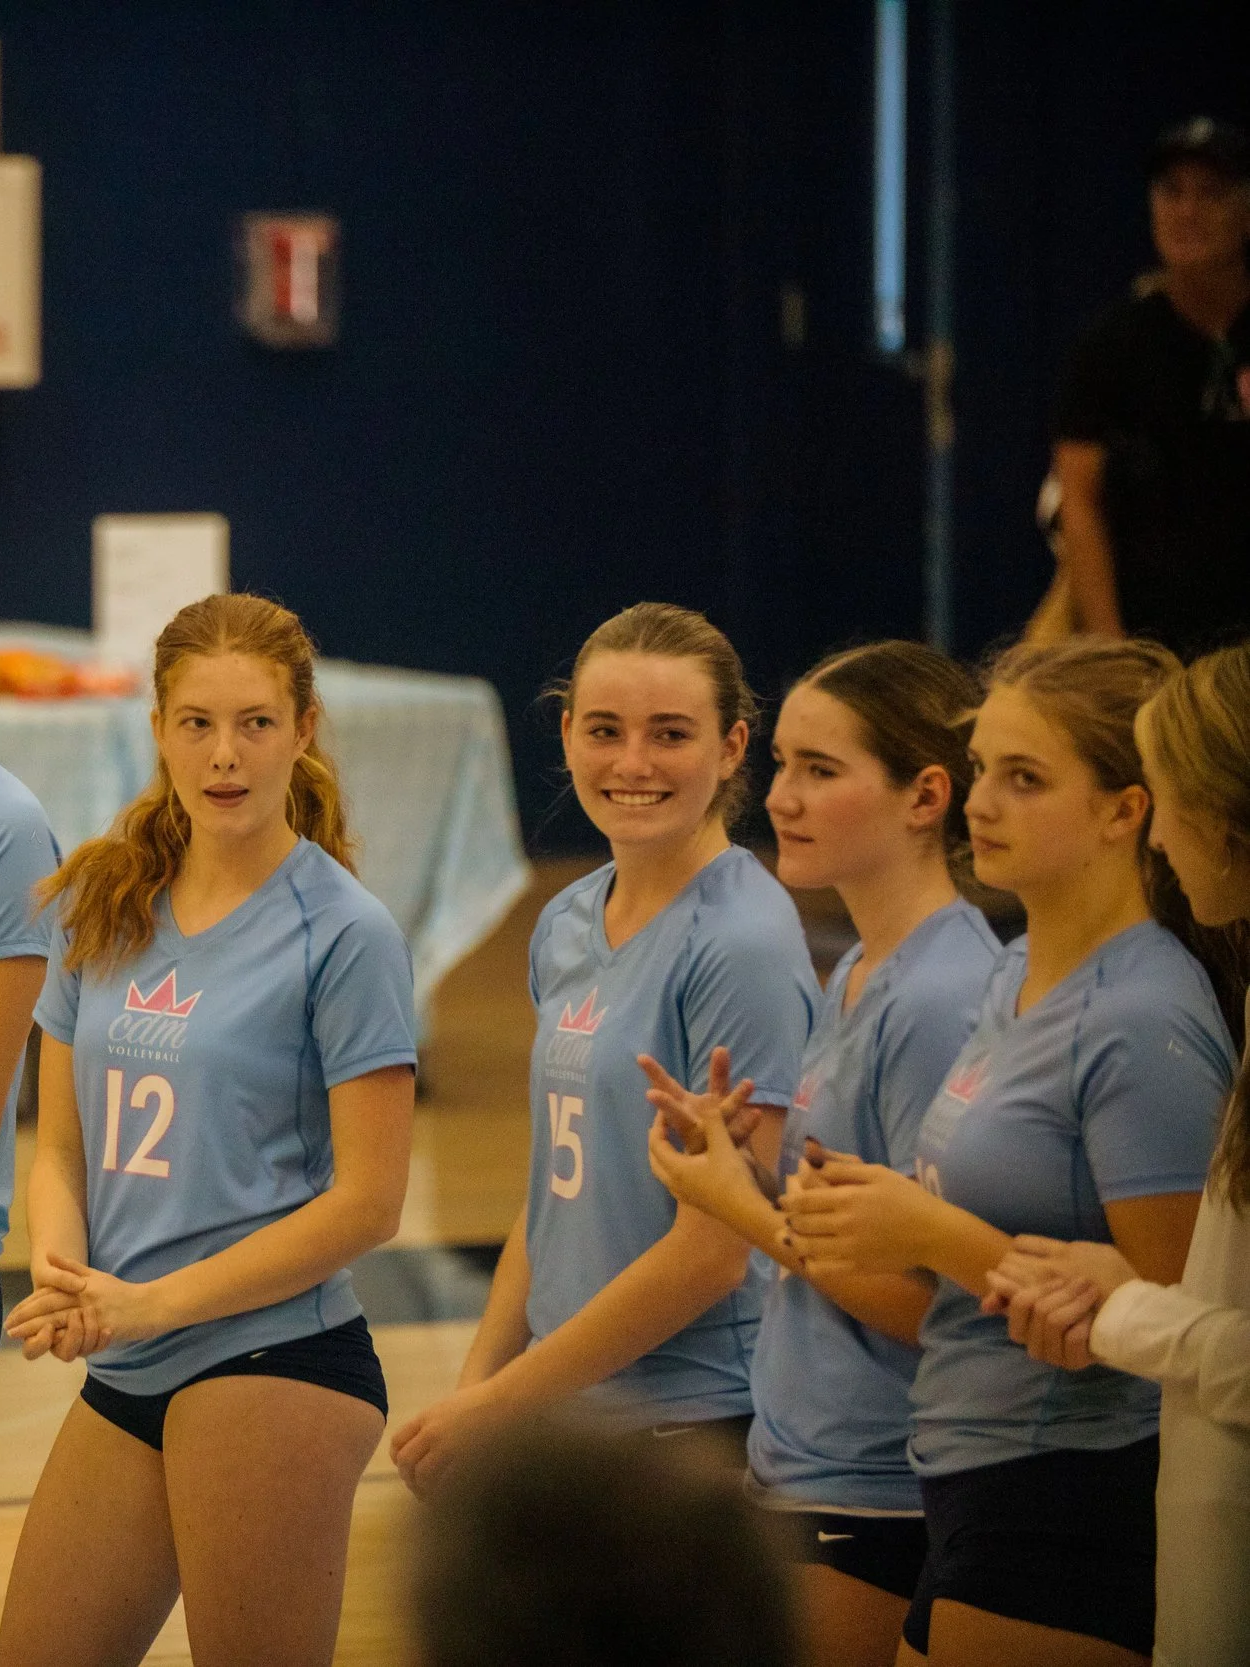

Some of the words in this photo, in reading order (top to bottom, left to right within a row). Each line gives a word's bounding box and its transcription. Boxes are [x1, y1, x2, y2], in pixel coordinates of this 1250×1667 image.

[108, 1005, 190, 1049] cdm
[108, 1045, 180, 1063] VOLLEYBALL
[102, 1069, 175, 1178] 12
[548, 1092, 584, 1200] 15
